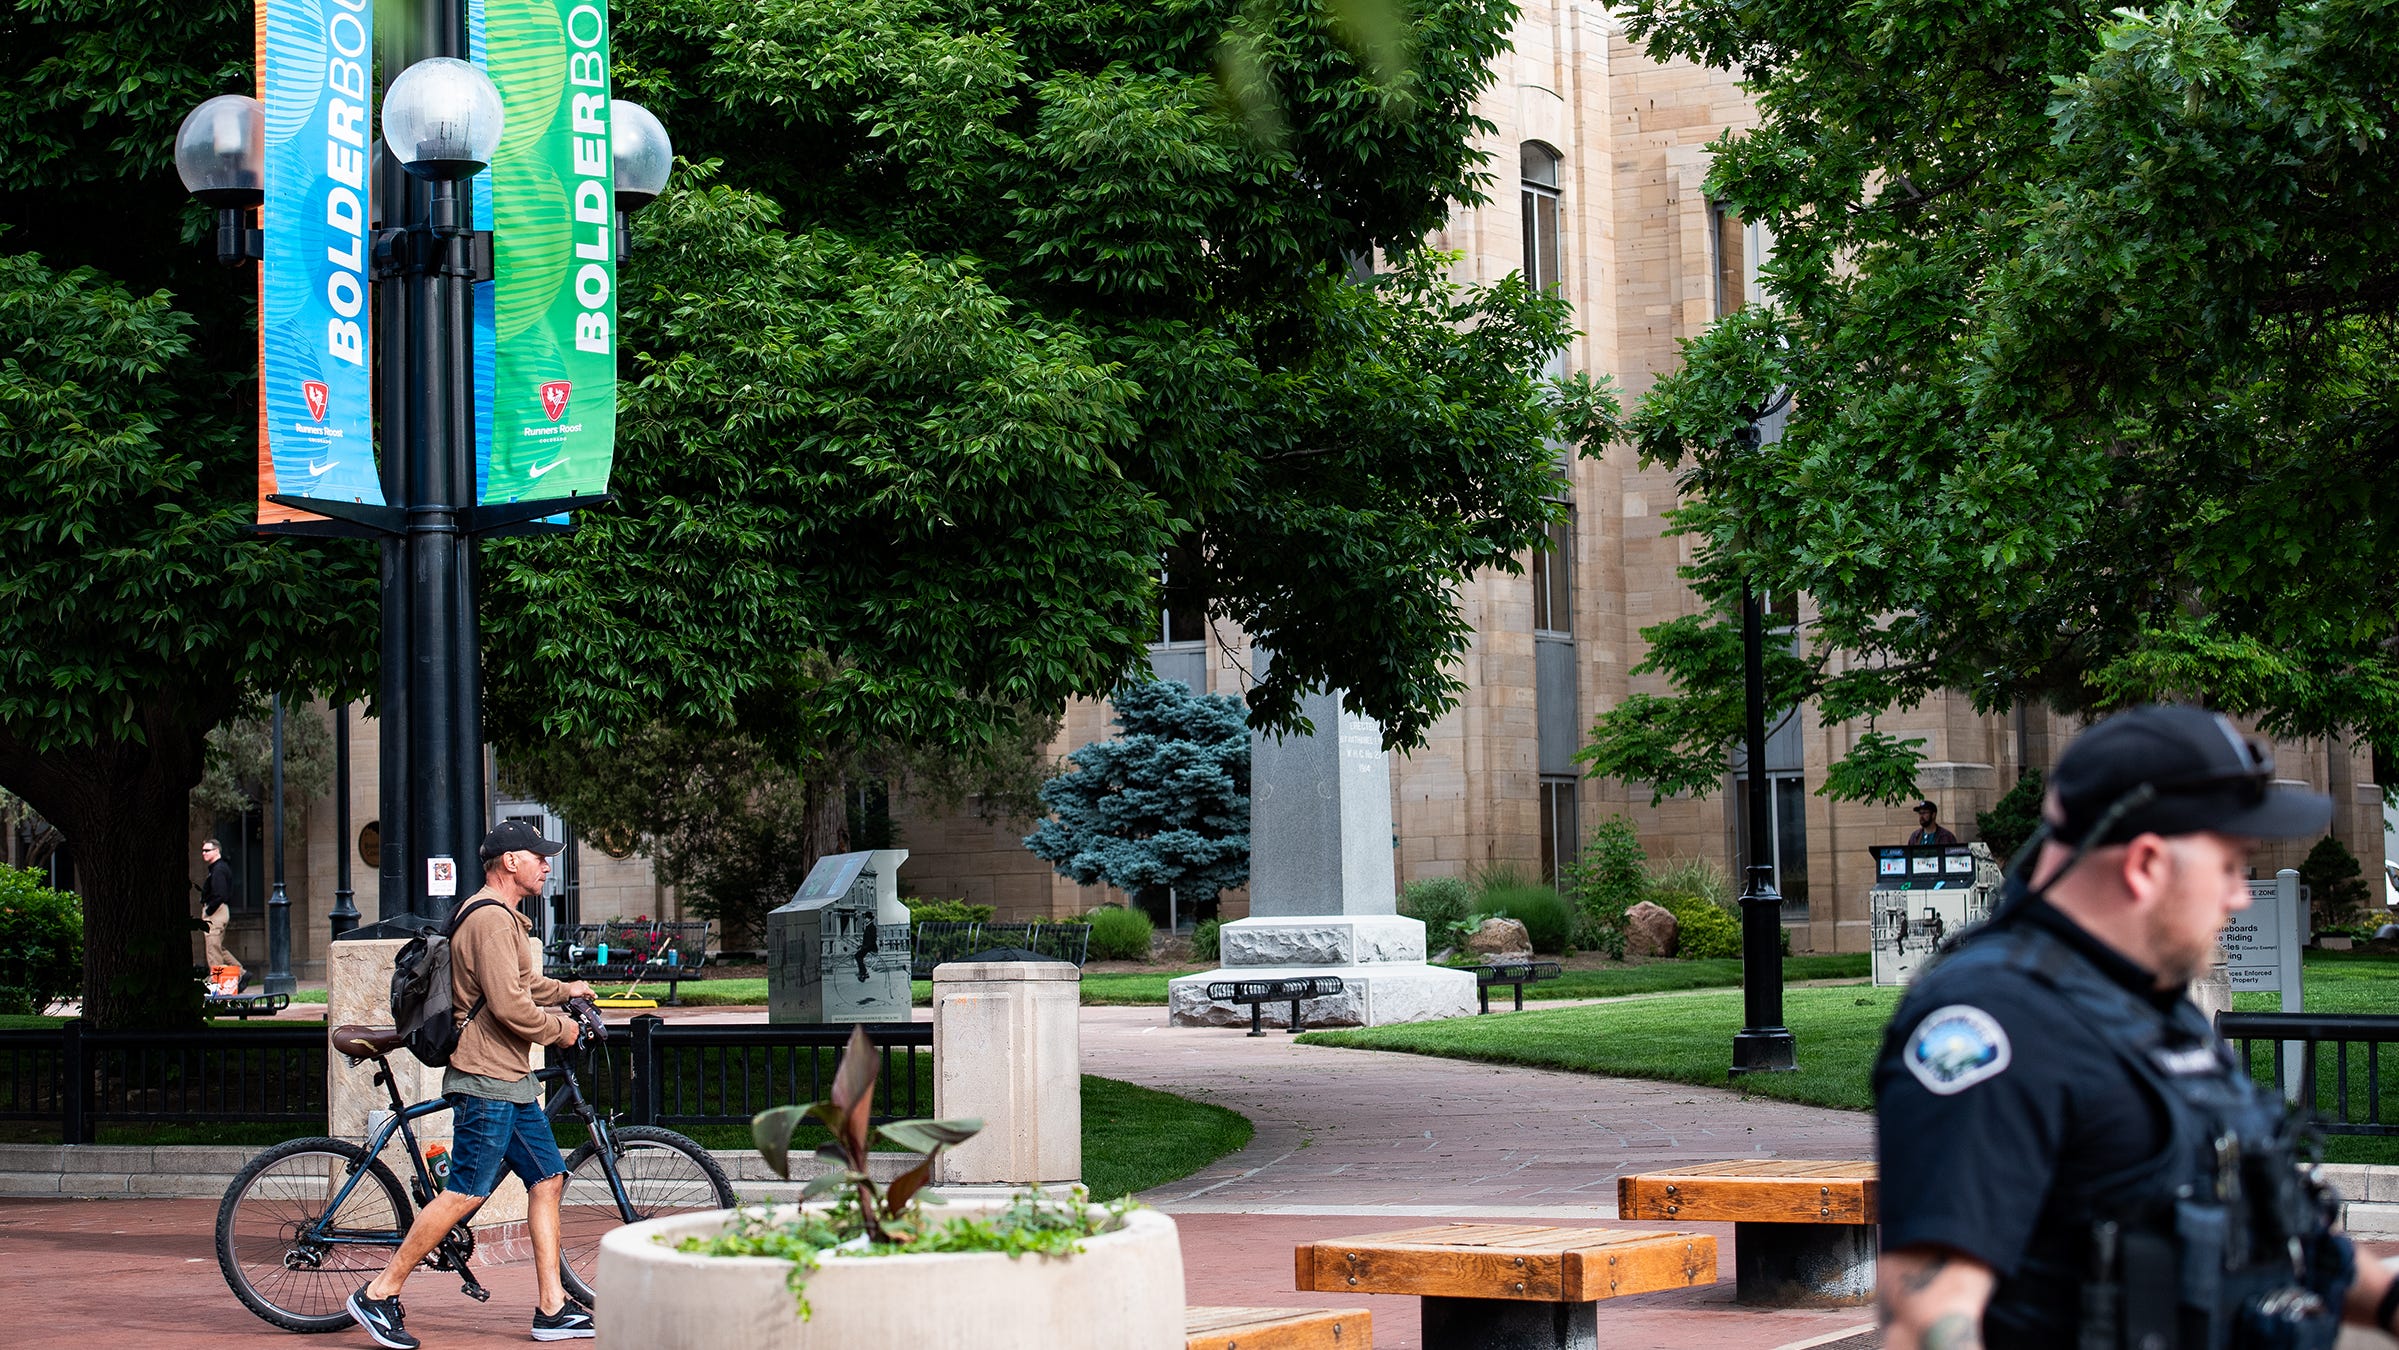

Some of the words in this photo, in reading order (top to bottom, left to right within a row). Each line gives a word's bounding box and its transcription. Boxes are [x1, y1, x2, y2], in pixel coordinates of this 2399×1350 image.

[327, 0, 366, 367] BOLDERBO
[567, 0, 610, 355] BOLDERBO
[295, 422, 323, 435] Runners
[323, 426, 344, 438] Roost
[524, 427, 559, 436] Runners
[559, 423, 582, 433] Roost
[2226, 933, 2253, 942] Riding
